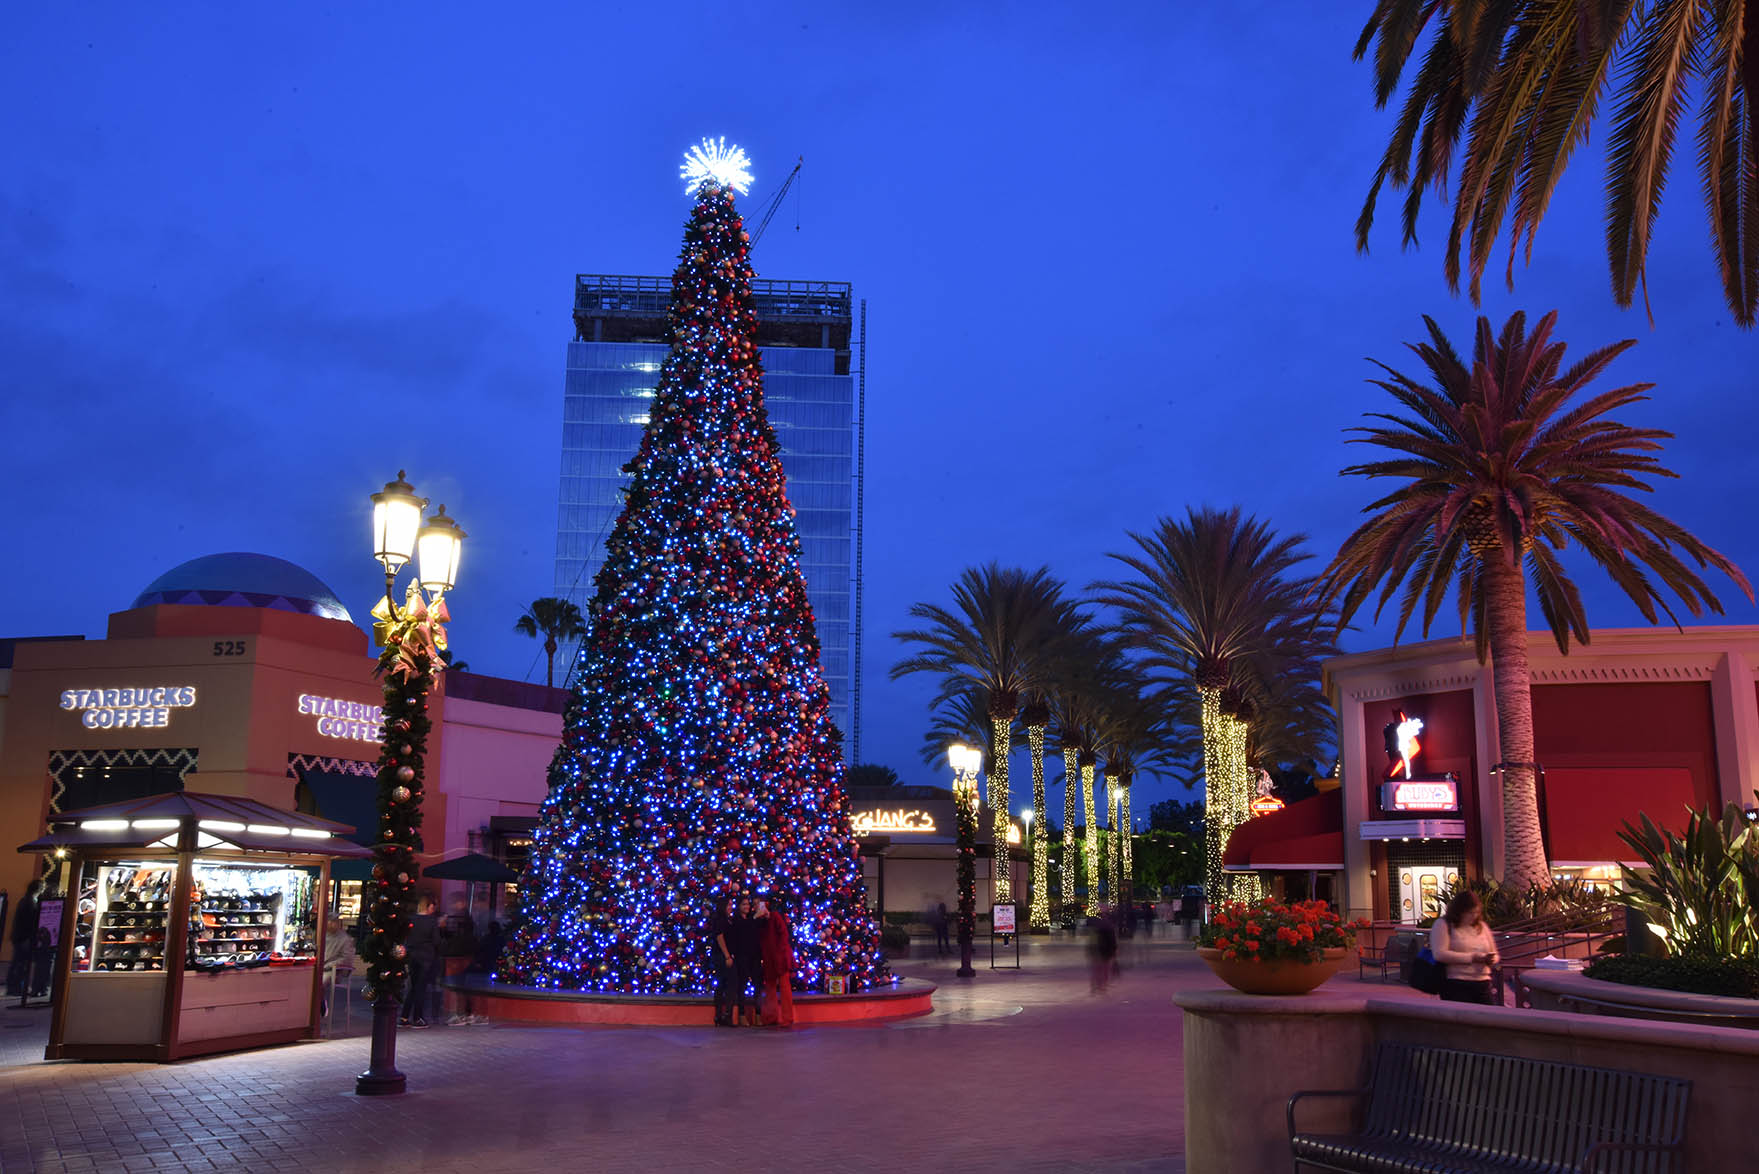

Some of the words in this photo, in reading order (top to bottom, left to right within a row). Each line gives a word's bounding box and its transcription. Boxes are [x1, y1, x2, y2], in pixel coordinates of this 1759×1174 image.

[213, 641, 246, 657] 525
[59, 686, 196, 710] STARBUCKS
[298, 694, 386, 724] STARBUC
[82, 707, 169, 729] COFFEE
